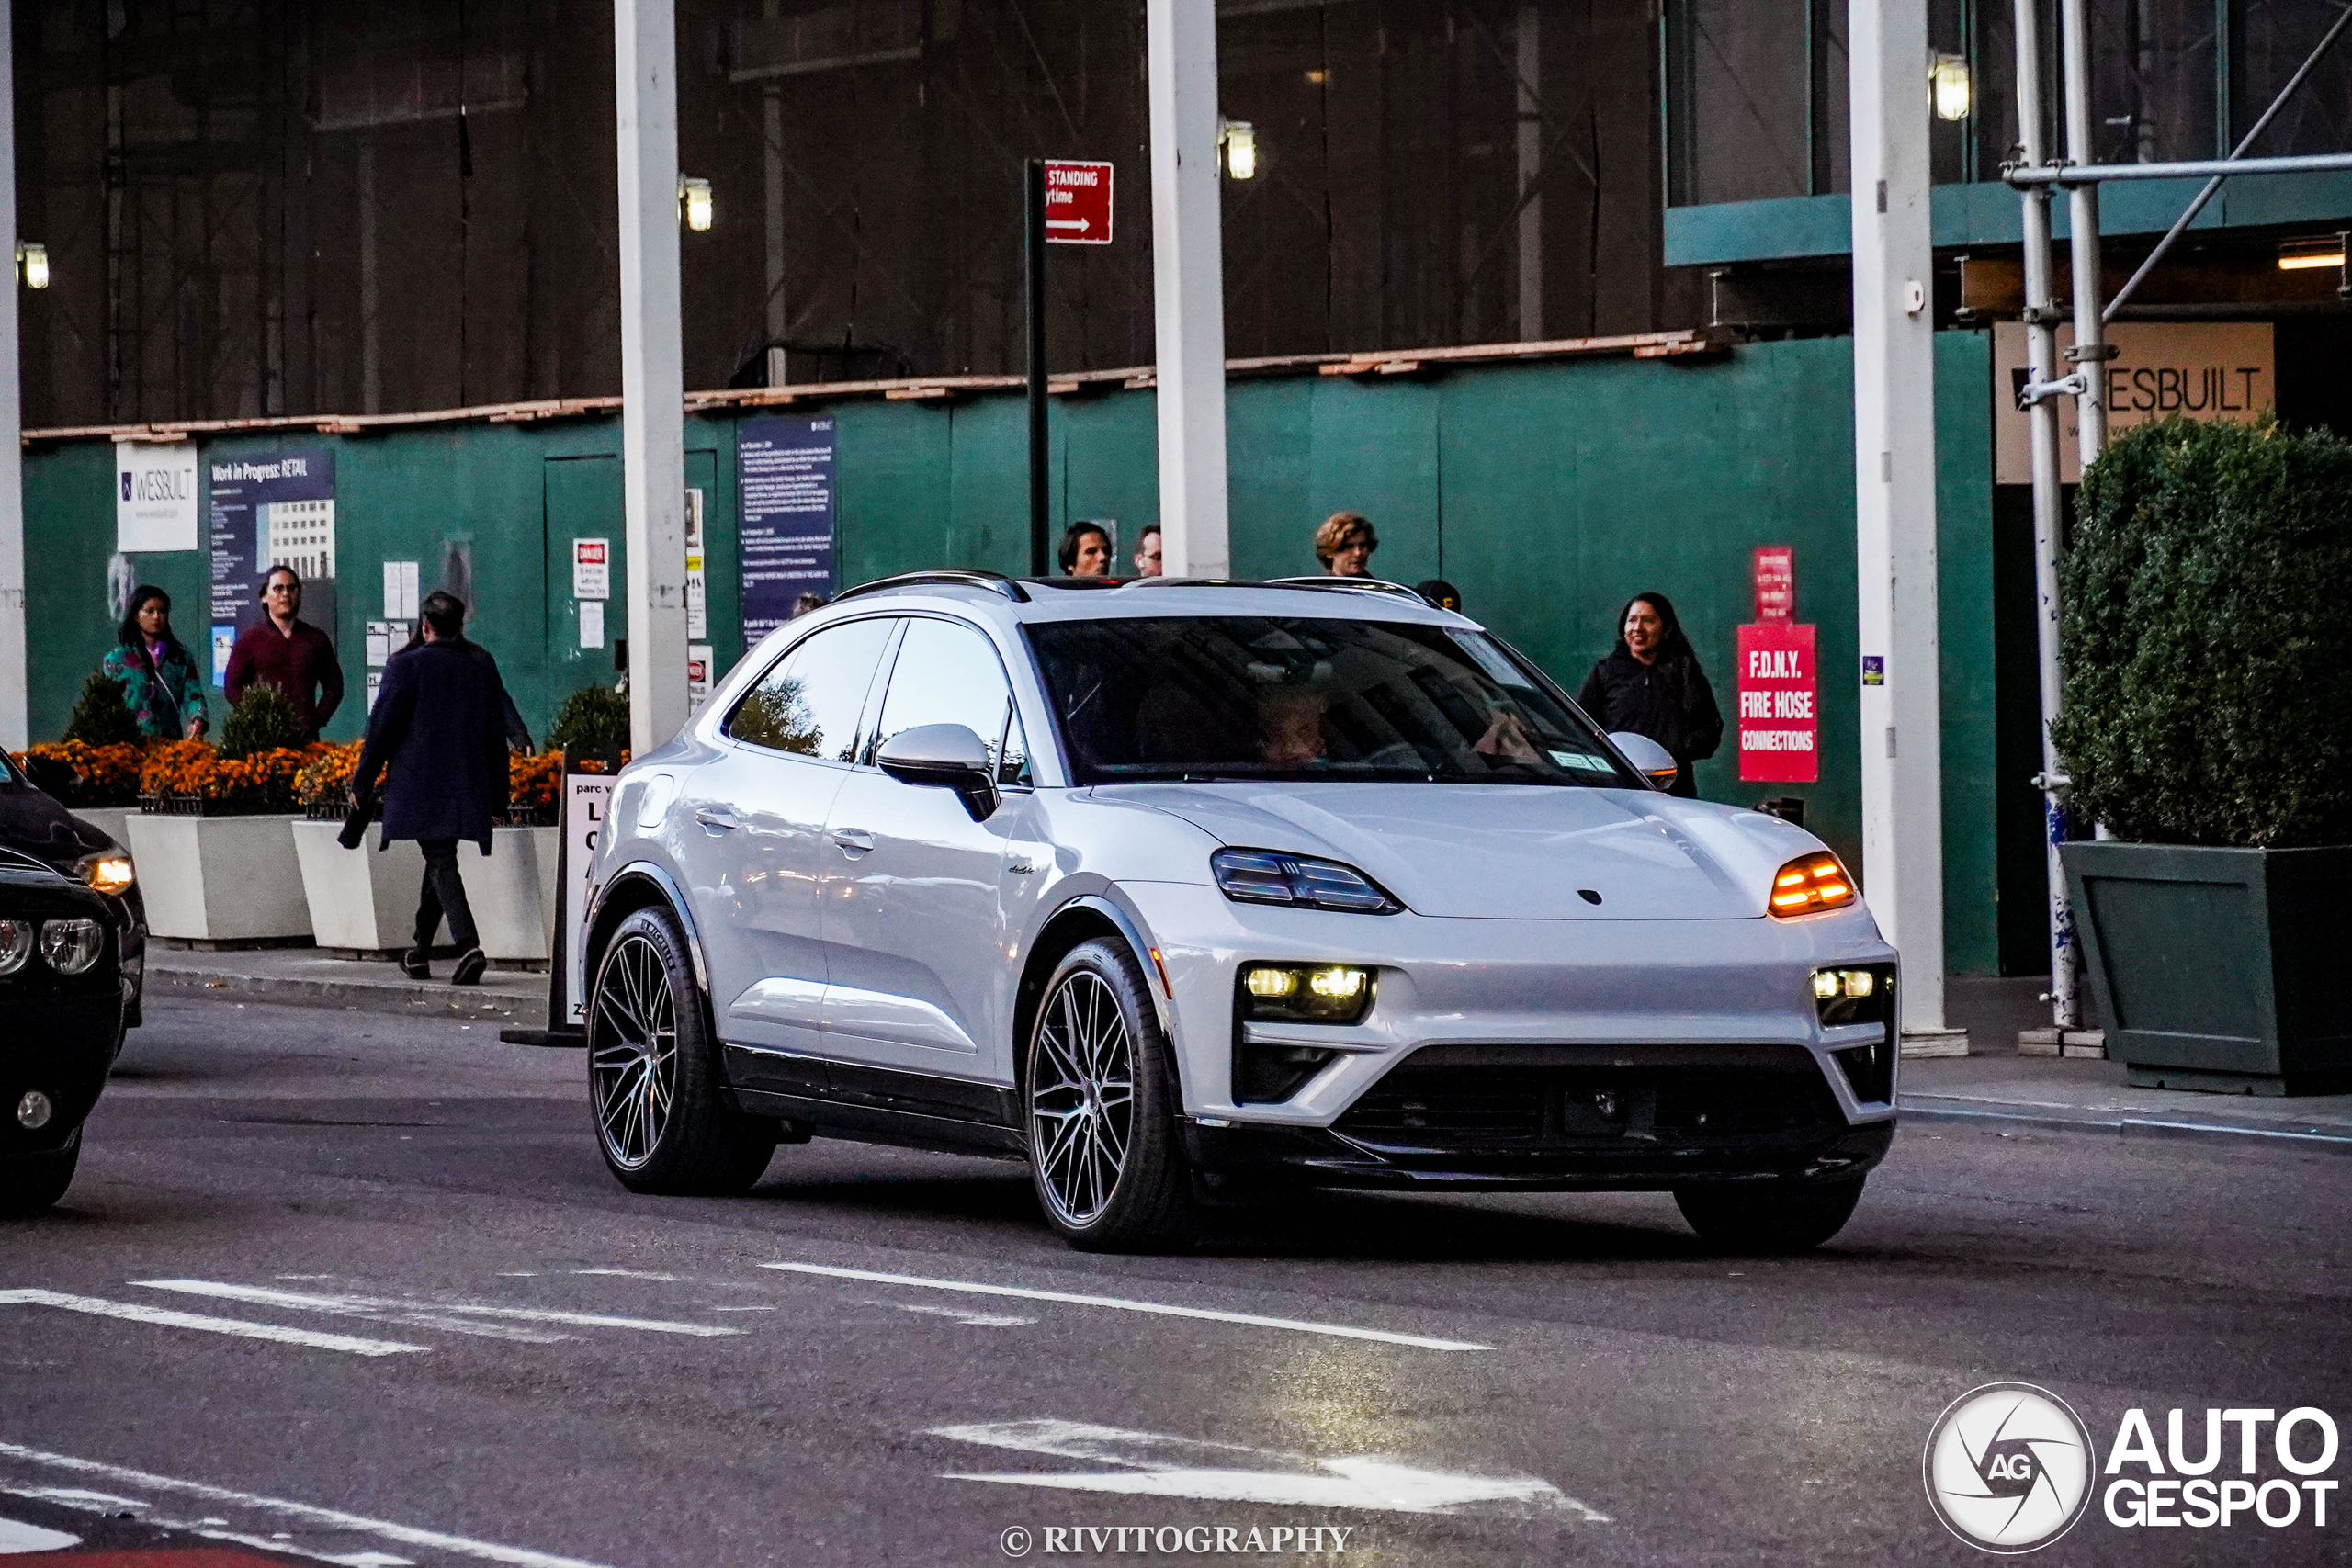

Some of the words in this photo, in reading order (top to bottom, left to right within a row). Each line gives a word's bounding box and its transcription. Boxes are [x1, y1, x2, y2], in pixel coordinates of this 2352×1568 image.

[1048, 170, 1098, 186] STANDING
[1046, 188, 1073, 207] ytime
[2068, 367, 2260, 412] ESBUILT
[211, 463, 232, 481] Work
[232, 462, 242, 480] in
[243, 462, 280, 483] Progress:
[281, 458, 308, 477] RETAIL
[134, 468, 192, 502] WESBUILT
[1749, 650, 1802, 678] F.D.N.Y.
[1740, 691, 1772, 719] FIRE
[1774, 690, 1814, 719] HOSE
[1741, 729, 1814, 751] CONNECTIONS
[576, 784, 602, 795] parc
